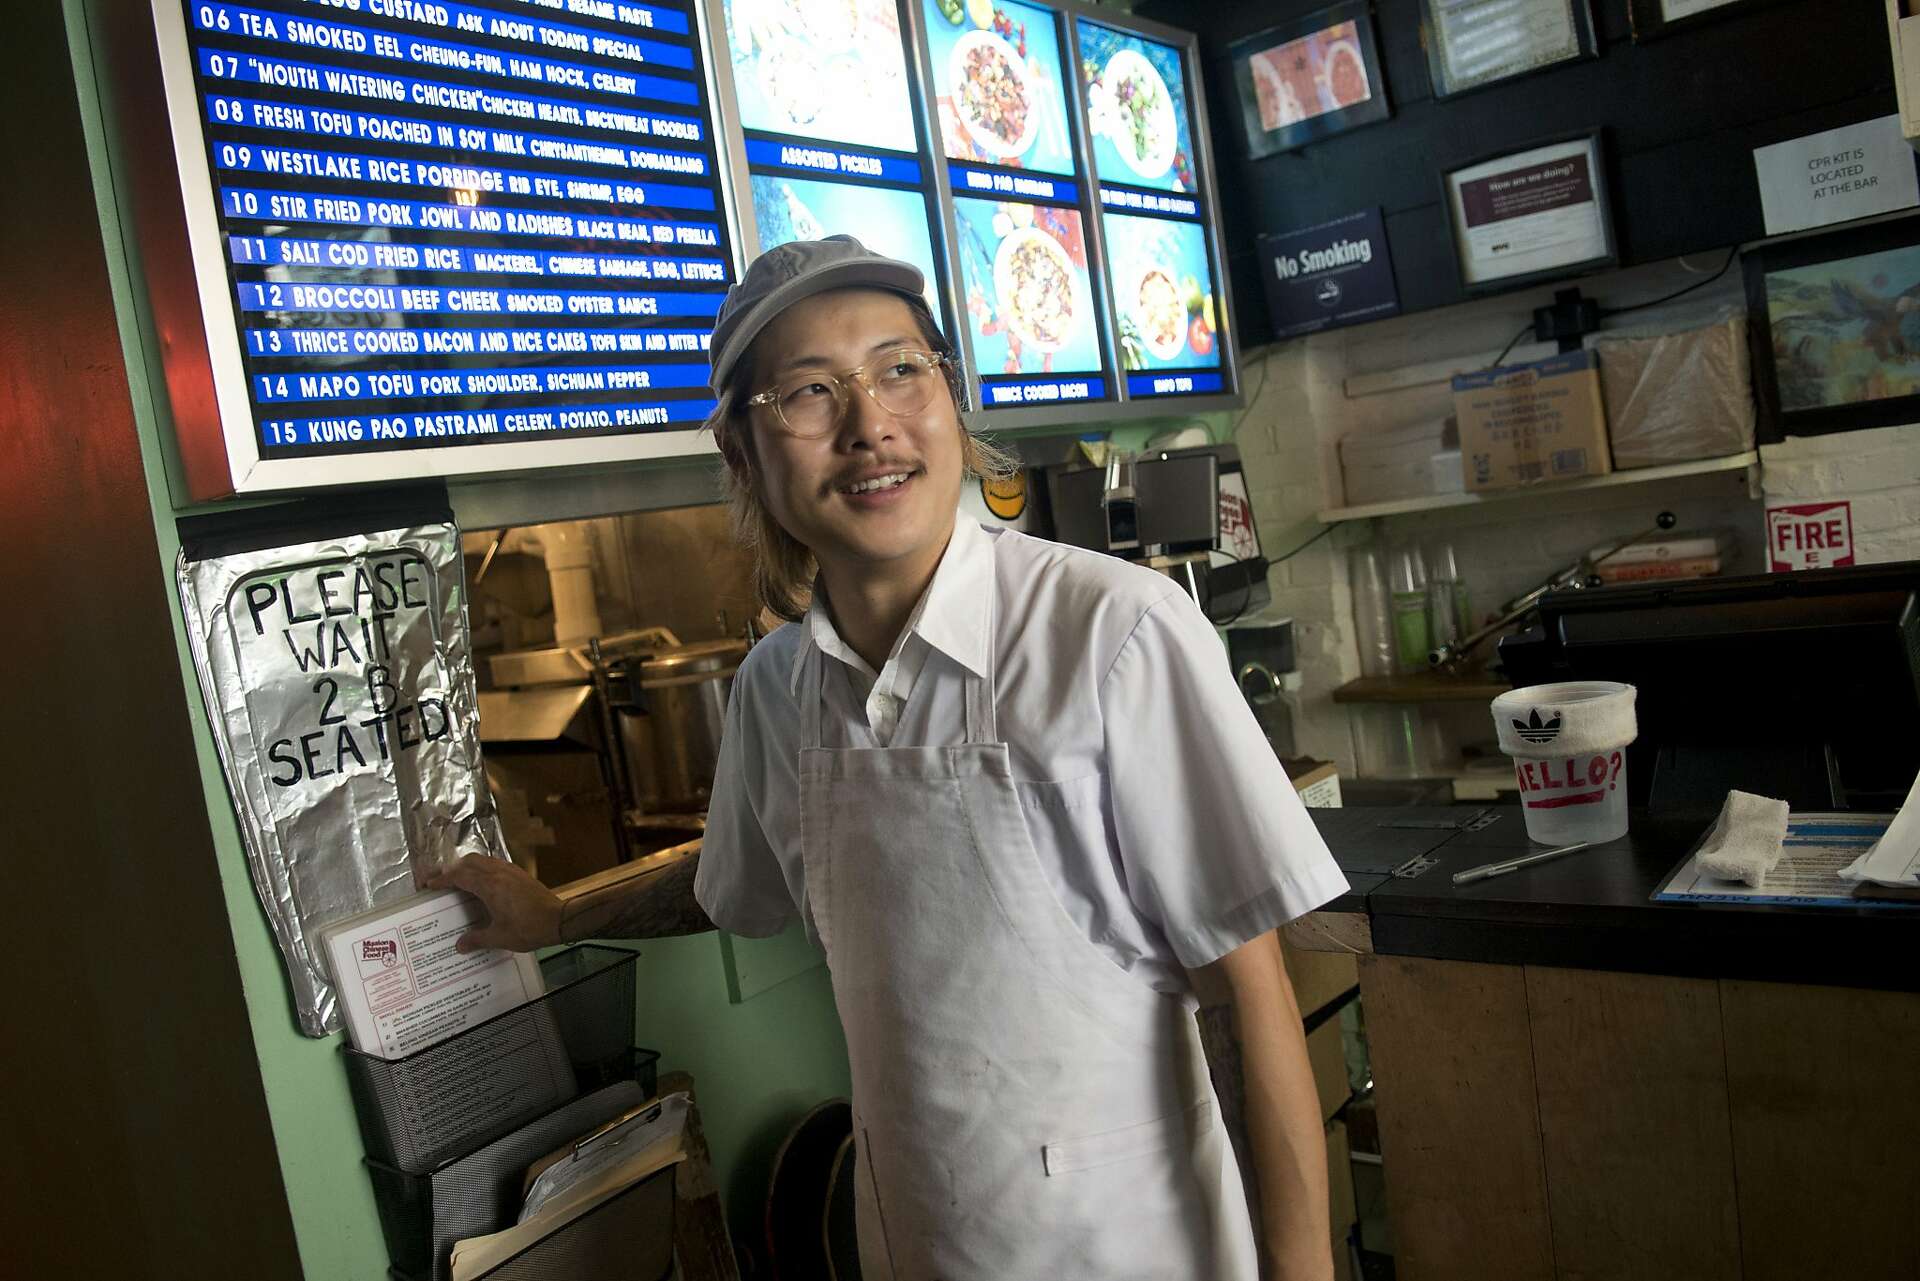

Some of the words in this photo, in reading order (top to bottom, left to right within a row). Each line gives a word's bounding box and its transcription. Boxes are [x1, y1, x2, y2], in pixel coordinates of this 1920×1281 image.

[368, 0, 449, 27] CUSTARD
[456, 12, 485, 34] ASK
[490, 18, 534, 42] ABOUT
[538, 27, 590, 52] TODAYS
[592, 37, 644, 62] SPECIAL
[617, 5, 653, 28] PASTE
[200, 6, 230, 31] 06
[239, 12, 279, 39] TEA
[286, 20, 367, 52] SMOKED
[373, 34, 403, 59] EEL
[410, 43, 506, 77] CHEUNG-FUN,
[509, 59, 543, 80] HAM
[545, 64, 590, 90] HOCK,
[592, 72, 636, 95] CELERY
[210, 54, 238, 78] 07
[248, 57, 320, 90] "MOUTH
[324, 71, 406, 102] WATERING
[537, 103, 584, 127] HEARTS,
[585, 109, 649, 134] BUCKWHEAT
[651, 118, 700, 141] NOODLES
[215, 98, 244, 123] 08
[253, 104, 306, 130] FRESH
[310, 111, 353, 136] TOFU
[357, 116, 432, 144] POACHED
[437, 126, 454, 147] IN
[458, 128, 486, 151] SOY
[492, 132, 526, 155] MILK
[222, 145, 251, 168] 09
[261, 149, 362, 179] WESTLAKE
[368, 159, 411, 184] RICE
[417, 164, 503, 192] PORRIDGE
[508, 175, 531, 194] RIB
[534, 178, 564, 199] EYE,
[566, 181, 614, 204] SHRIMP,
[616, 185, 645, 204] EGG
[1808, 155, 1831, 170] CPR
[1833, 151, 1850, 164] KIT
[1853, 148, 1864, 160] IS
[1810, 164, 1864, 185] LOCATED
[1488, 181, 1510, 192] How
[1814, 187, 1826, 200] AT
[1830, 182, 1851, 196] THE
[1854, 176, 1878, 190] BAR
[231, 191, 258, 215] 10
[270, 195, 308, 219] STIR
[313, 198, 361, 222] FRIED
[367, 202, 413, 226] PORK
[419, 206, 463, 229] JOWL
[469, 209, 502, 232] AND
[505, 212, 574, 237] RADISHES
[576, 219, 616, 239] BLACK
[617, 222, 651, 244] BEAN,
[652, 225, 674, 243] RED
[675, 227, 717, 246] PERILLA
[241, 238, 266, 261] 11
[280, 240, 321, 266] SALT
[328, 243, 369, 266] COD
[374, 245, 419, 268] FRIED
[423, 248, 462, 270] RICE
[473, 253, 544, 276] MACKEREL,
[548, 256, 597, 276] CHINESE
[598, 258, 652, 279] SAUSAGE,
[652, 261, 681, 281] EGG,
[681, 262, 724, 281] LETTUCE
[1274, 255, 1299, 280] No
[1299, 238, 1372, 273] Smoking
[254, 284, 284, 307] 12
[292, 284, 396, 310] BROCCOLI
[400, 289, 441, 310] BEEF
[447, 290, 502, 312] CHEEK
[506, 294, 564, 313] SMOKED
[567, 295, 615, 314] OYSTER
[617, 296, 658, 315] SAUCE
[253, 330, 282, 353] 13
[291, 331, 349, 353] THRICE
[353, 331, 419, 353] COOKED
[423, 331, 475, 353] BACON
[479, 332, 509, 352] AND
[511, 331, 544, 352] RICE
[546, 331, 588, 352] CAKES
[590, 334, 618, 351] TOFU
[618, 334, 643, 351] SKIN
[645, 334, 667, 351] AND
[668, 334, 699, 351] BITTER
[262, 376, 289, 398] 14
[299, 375, 360, 398] MAPO
[367, 374, 414, 396] TOFU
[420, 376, 463, 395] PORK
[467, 374, 543, 393] SHOULDER,
[546, 372, 605, 391] SICHUAN
[607, 371, 651, 389] PEPPER
[270, 421, 297, 444] 15
[308, 419, 363, 443] KUNG
[370, 417, 408, 440] PAO
[414, 413, 499, 437] PASTRAMI
[615, 407, 669, 426] PEANUTS
[1777, 520, 1844, 551] FIRE
[245, 558, 427, 635] PLEASE
[283, 612, 395, 672] WAIT
[312, 677, 347, 726] 2
[368, 666, 398, 714] B
[268, 698, 450, 787] SEATED
